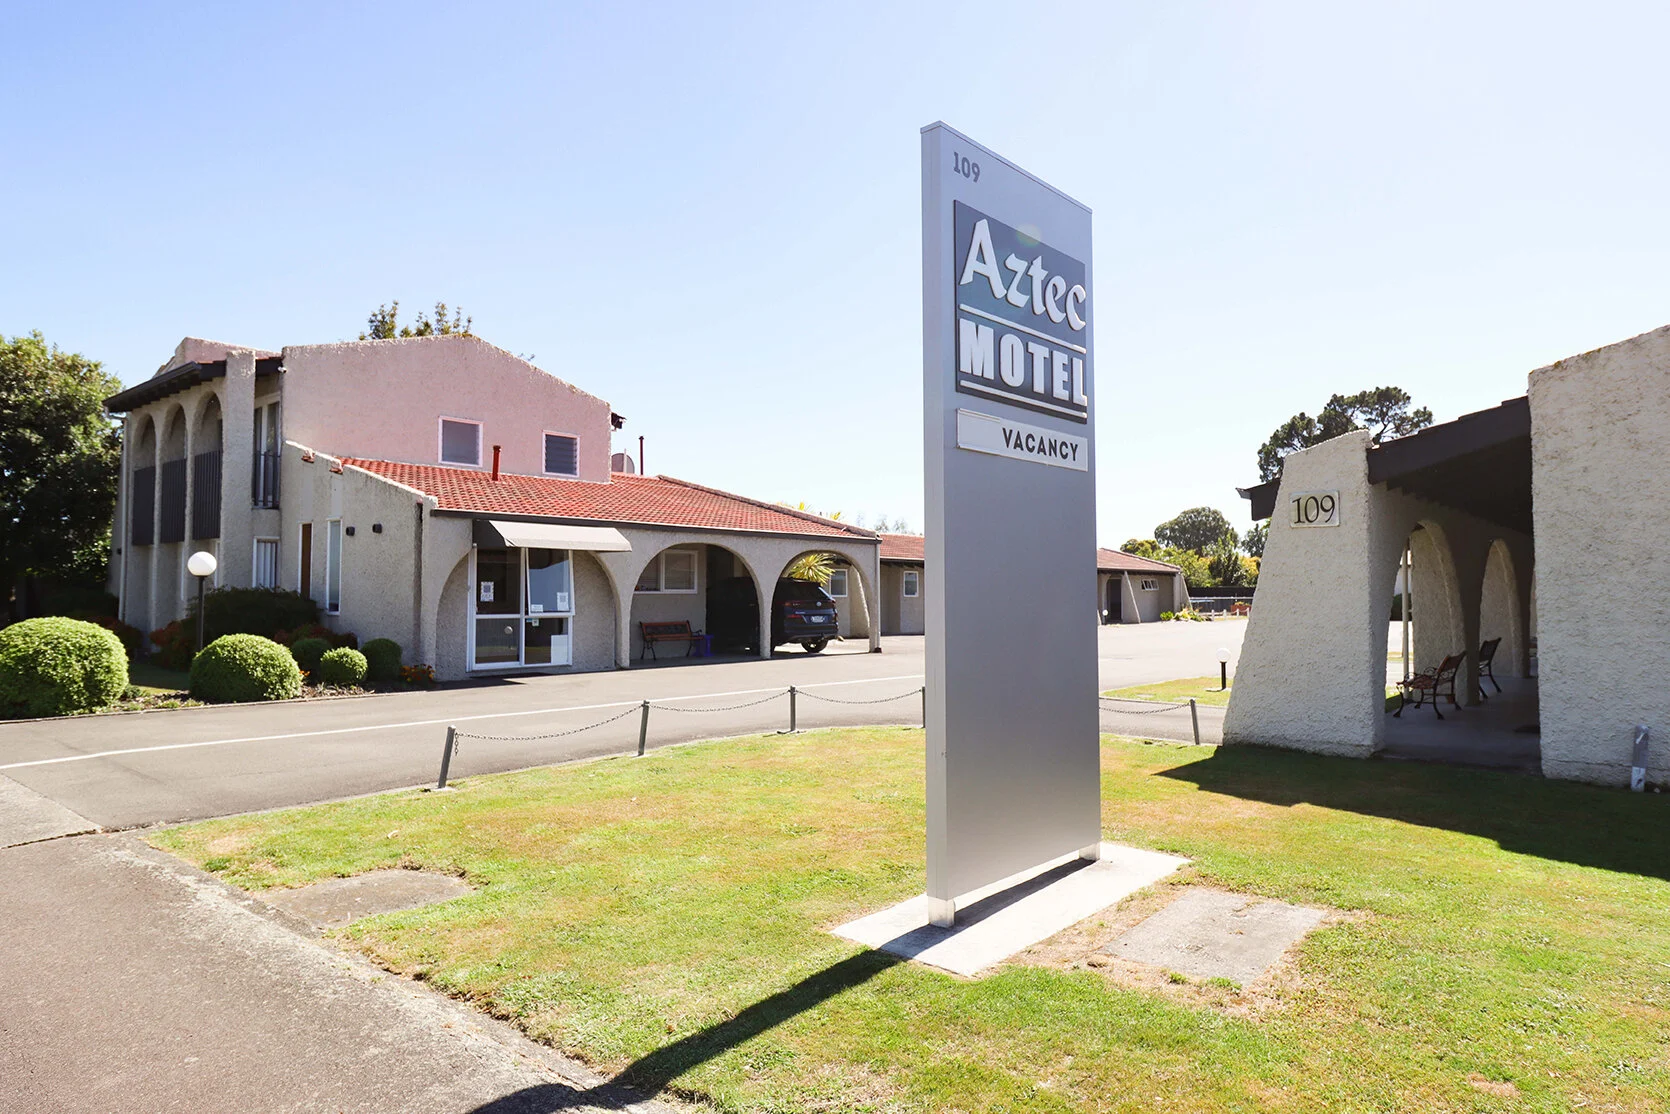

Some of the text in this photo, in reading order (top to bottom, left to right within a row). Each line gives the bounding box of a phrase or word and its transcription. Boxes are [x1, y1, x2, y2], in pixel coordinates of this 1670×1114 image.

[953, 152, 980, 183] 109
[960, 218, 1087, 331] Aztec
[959, 318, 1087, 406] MOTEL
[1003, 427, 1079, 461] VACANCY
[1292, 495, 1335, 524] 109
